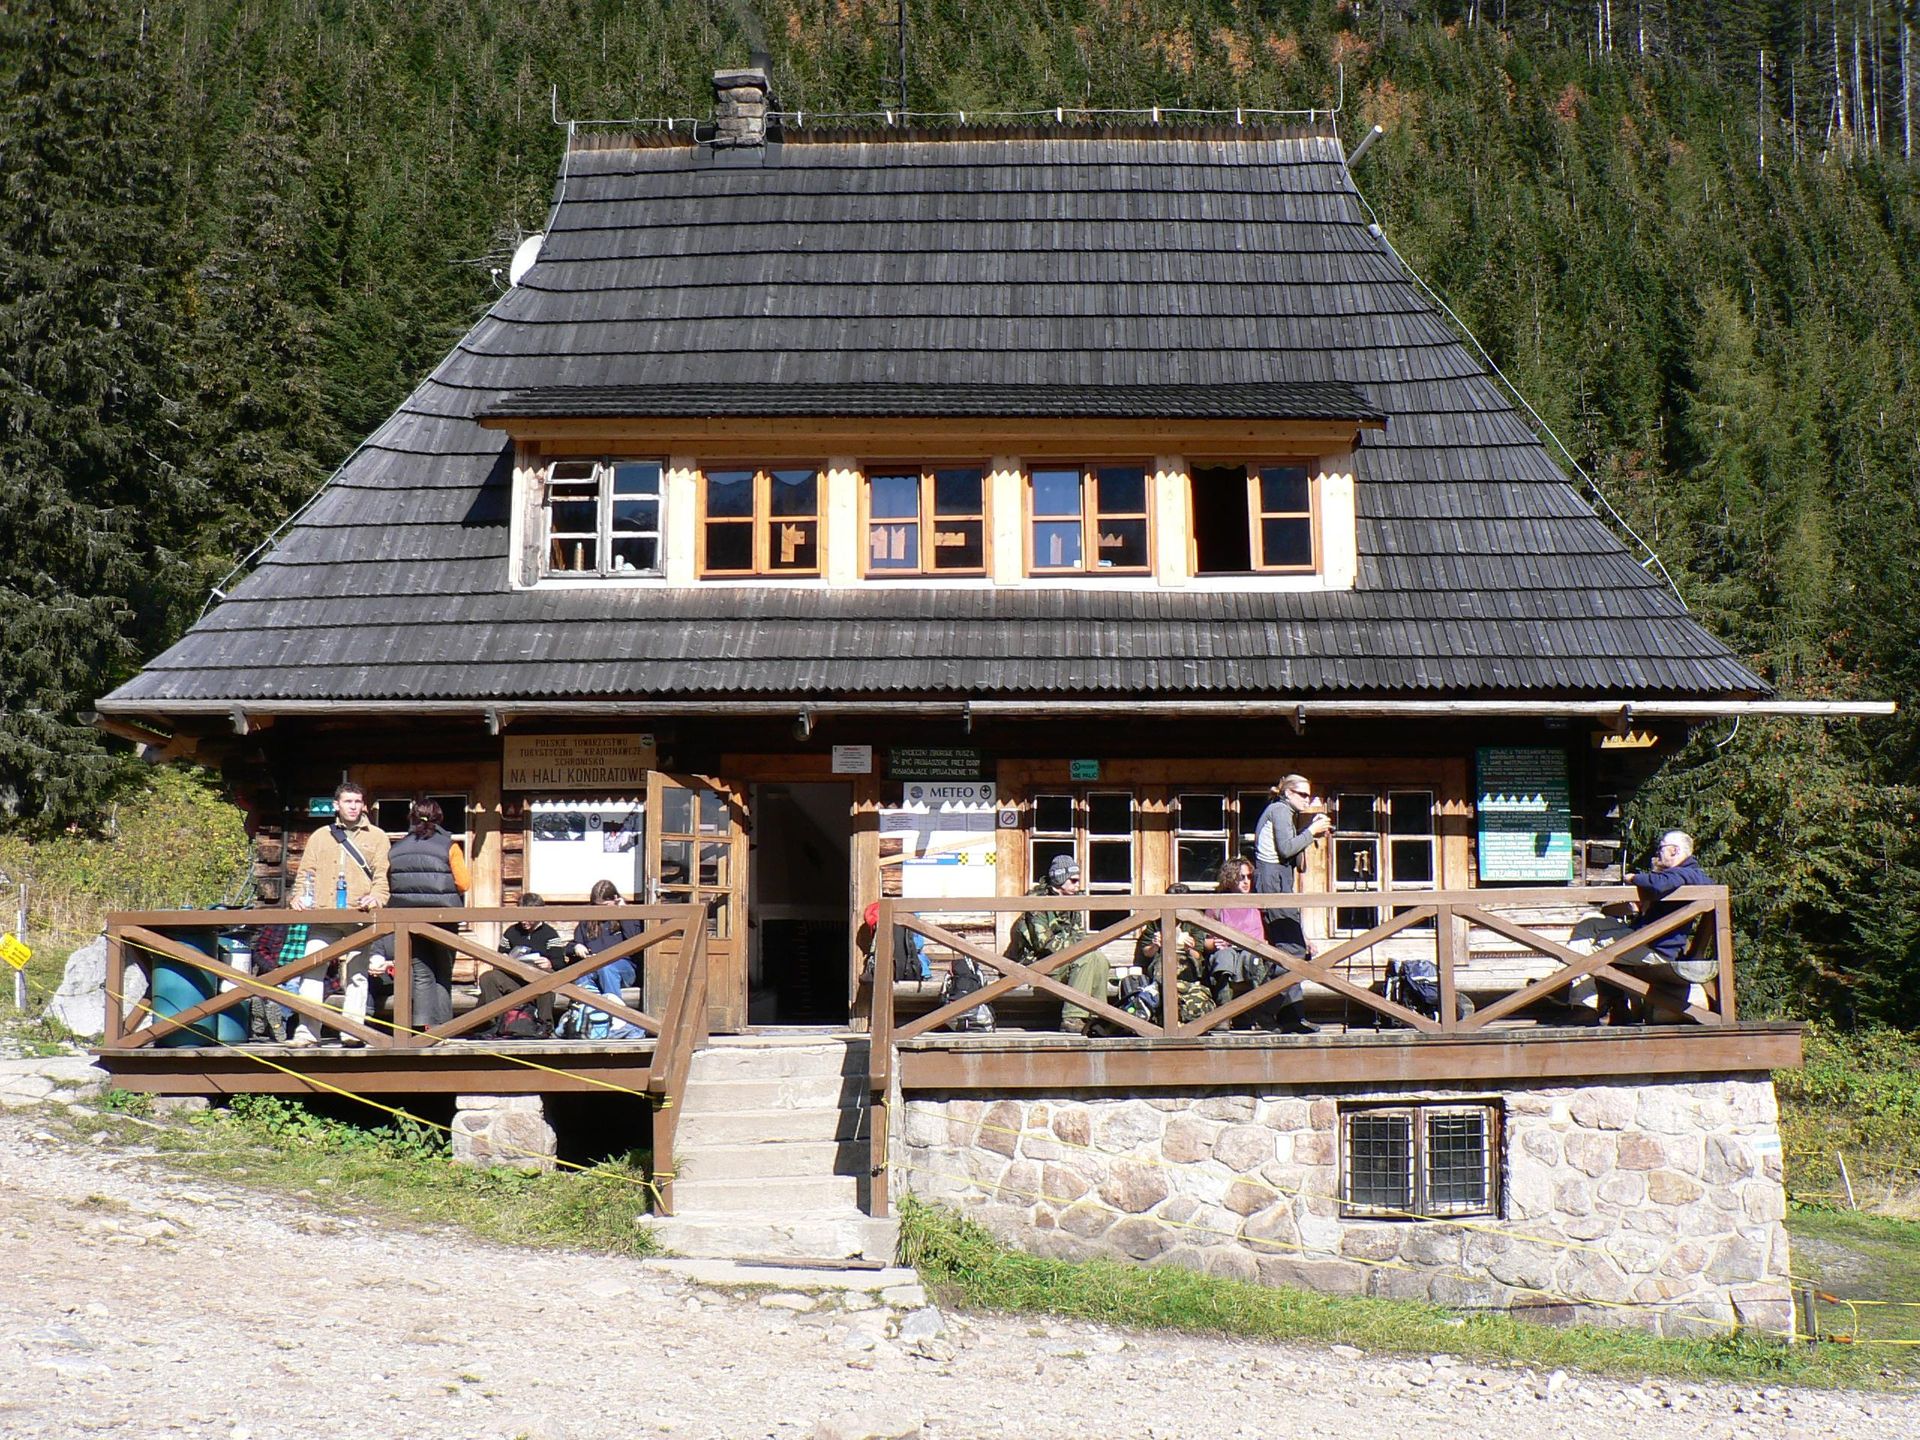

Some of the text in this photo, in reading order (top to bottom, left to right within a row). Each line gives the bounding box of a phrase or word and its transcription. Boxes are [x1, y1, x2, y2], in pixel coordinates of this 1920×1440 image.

[535, 737, 628, 747] POLSKIE TOWARZYSTWO
[520, 748, 573, 758] TURYSTYCZNO
[584, 746, 641, 757] KRAJOZNAWCZE
[554, 757, 605, 767] SCHRONISKO
[510, 768, 527, 784] NA
[532, 768, 561, 784] HALI
[929, 786, 975, 798] METEO
